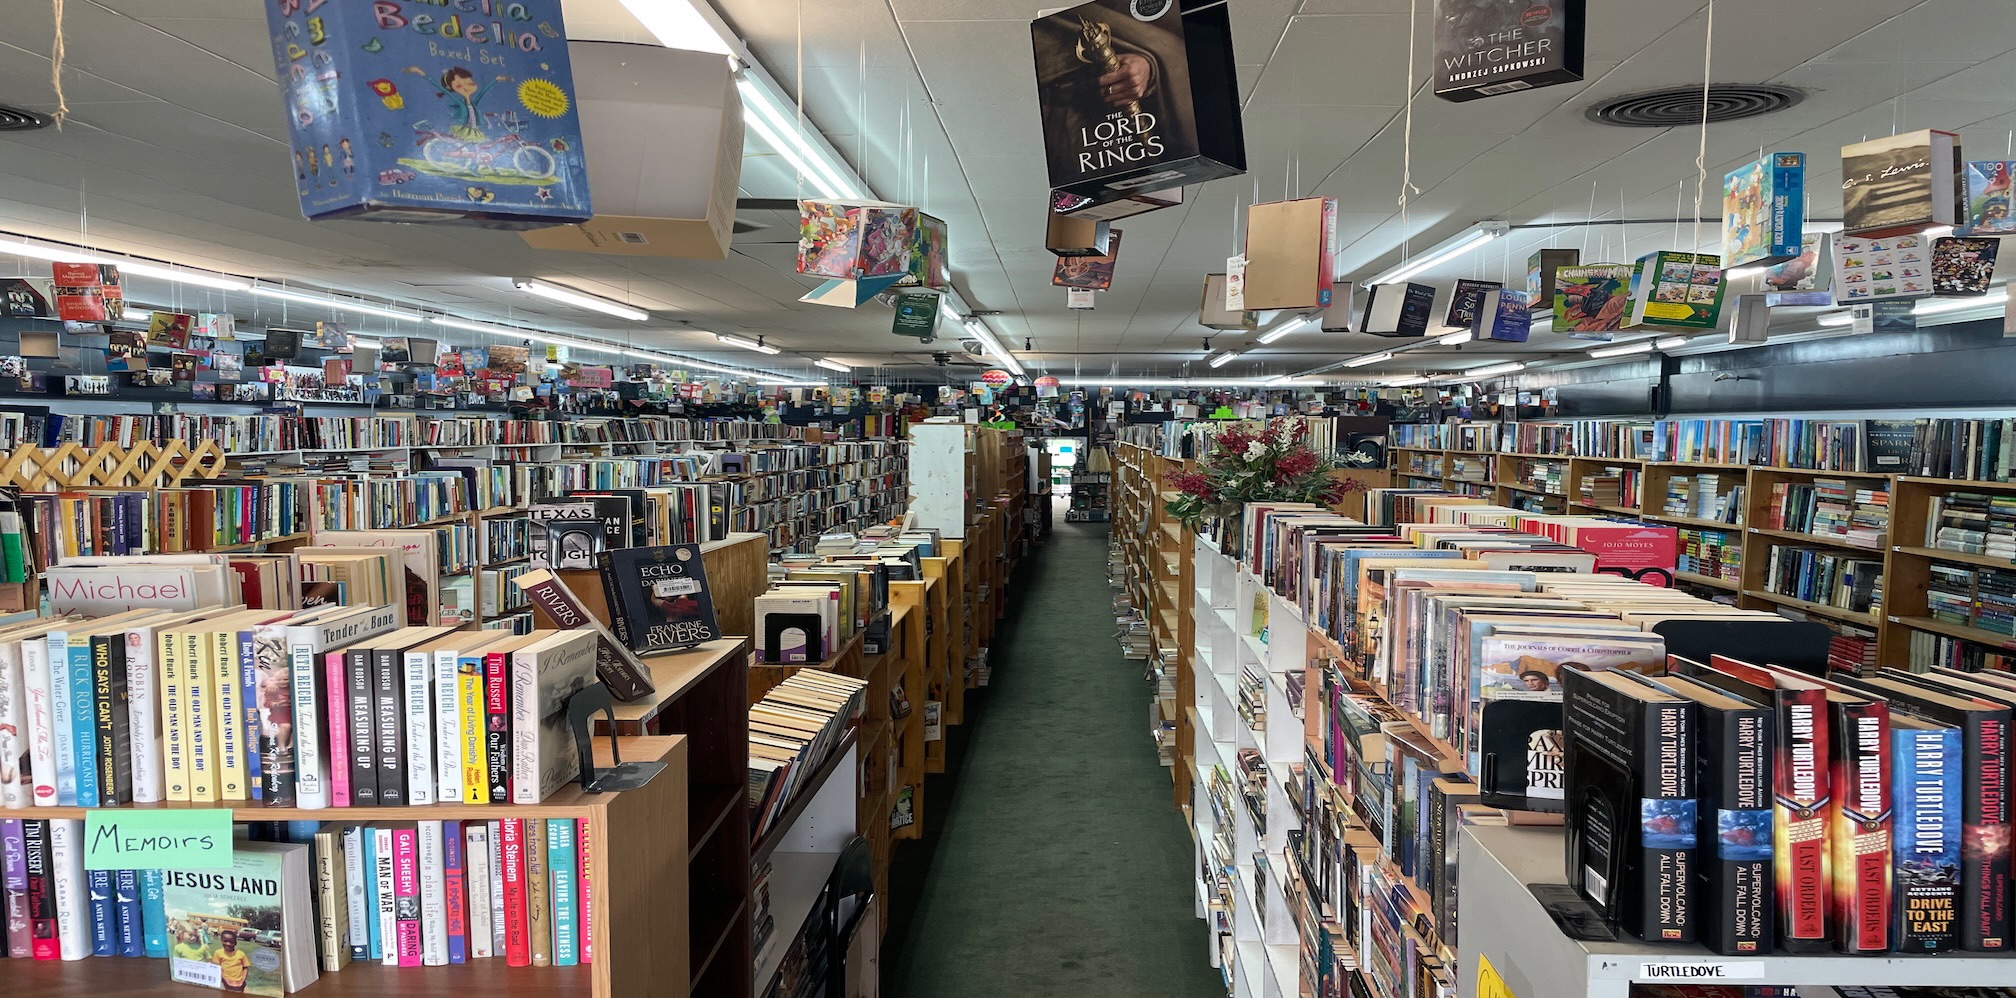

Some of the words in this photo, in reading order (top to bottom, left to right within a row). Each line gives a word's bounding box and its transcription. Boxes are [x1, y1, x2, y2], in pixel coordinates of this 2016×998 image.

[373, 1, 543, 53] Bedelia
[1488, 28, 1523, 45] THE
[428, 40, 471, 62] Boxed
[479, 49, 506, 67] Set
[1444, 39, 1552, 70] WITCHER
[1449, 70, 1489, 82] ANDRZEJ
[1492, 57, 1546, 74] SAPKOWSKI
[1105, 111, 1123, 121] THE
[1082, 112, 1156, 147] LORD
[1102, 139, 1114, 148] OF
[1116, 135, 1133, 144] THE
[1078, 136, 1165, 173] RINGS
[1983, 162, 2004, 170] 100
[1842, 179, 1857, 190] C.
[528, 508, 592, 520] TEXAS
[640, 564, 683, 577] ECHO
[54, 575, 186, 600] Michael
[536, 585, 581, 627] RIVERS
[323, 622, 359, 644] Tender
[371, 612, 394, 630] Bone
[646, 626, 712, 646] RIVERS
[650, 620, 703, 634] FRANCINE
[95, 643, 108, 667] WHO
[295, 648, 309, 671] RUTH
[354, 654, 364, 667] DAN
[380, 655, 390, 667] DAN
[1587, 648, 1632, 656] CHRISTOPHER
[53, 659, 64, 675] The
[74, 654, 88, 685] RICK
[409, 658, 423, 681] RUTH
[440, 656, 453, 679] RUTH
[489, 656, 502, 674] Tim
[54, 677, 65, 699] Water
[97, 669, 109, 694] SAYS
[126, 656, 136, 705] ROBERTS
[135, 664, 148, 700] ROBIN
[221, 683, 230, 695] THE
[355, 668, 365, 690] ROBSON
[381, 668, 391, 691] ROBSON
[466, 677, 474, 690] The
[168, 684, 176, 697] THE
[191, 686, 200, 698] THE
[297, 675, 312, 708] REICHL
[411, 684, 424, 716] REICHL
[441, 683, 454, 714] REICHL
[466, 691, 475, 706] Year
[490, 677, 502, 710] Russert
[55, 701, 67, 723] Giver
[76, 691, 91, 721] ROSS
[168, 698, 177, 712] OLD
[192, 699, 200, 713] OLD
[222, 697, 231, 710] OLD
[98, 701, 113, 730] CAN'T
[169, 713, 178, 727] MAN
[192, 714, 201, 728] MAN
[223, 712, 232, 727] MAN
[354, 696, 370, 754] MEASURING
[380, 697, 395, 754] MEASURING
[465, 713, 476, 735] Living
[1661, 708, 1677, 739] HARRY
[1791, 705, 1813, 739] HARRY
[170, 729, 179, 742] AND
[194, 730, 202, 743] AND
[224, 727, 233, 740] AND
[490, 733, 500, 749] Our
[1738, 717, 1755, 748] HARRY
[1858, 717, 1879, 751] HARRY
[1980, 719, 1998, 755] HARRY
[102, 736, 112, 756] JOTHY
[171, 743, 180, 755] THE
[195, 745, 203, 757] THE
[225, 741, 234, 754] THE
[467, 735, 477, 765] Danishly
[1915, 734, 1944, 776] HARRY
[80, 731, 94, 788] HURRICANES
[171, 756, 180, 770] BOY
[195, 758, 204, 771] BOY
[225, 755, 235, 769] BOY
[357, 756, 371, 769] UP
[383, 756, 397, 770] UP
[490, 751, 501, 784] Fathers
[1661, 740, 1677, 798] TURTLEDOVE
[104, 757, 115, 796] ROSENBERG
[1738, 749, 1755, 808] TURTLEDOVE
[1792, 742, 1815, 801] TURTLEDOVE
[1859, 754, 1881, 813] TURTLEDOVE
[1980, 755, 1999, 826] TURTLEDOVE
[1915, 780, 1944, 854] TURTLEDOVE
[25, 822, 42, 837] TIM
[548, 823, 558, 850] SCORAH
[559, 825, 570, 848] AMBER
[399, 834, 411, 856] GAIL
[27, 839, 43, 874] RUSSERT
[505, 844, 519, 882] Steinem
[1660, 854, 1671, 869] ALL
[1799, 846, 1814, 874] LAST
[378, 857, 392, 879] MAN
[400, 858, 412, 894] SHEEHY
[1736, 866, 1747, 880] ALL
[1865, 858, 1879, 885] LAST
[1980, 858, 1991, 891] THINGS
[56, 878, 67, 907] SARAH
[166, 870, 225, 890] JESUS
[230, 875, 278, 896] LAND
[380, 880, 389, 890] OF
[556, 870, 568, 903] LEAVING
[1660, 873, 1671, 894] FALL
[1675, 851, 1686, 926] SUPERVOLCANO:
[380, 891, 393, 914] WAR
[509, 898, 518, 910] Life
[1736, 884, 1747, 906] FALL
[1751, 863, 1762, 939] SUPERVOLCANO:
[1800, 876, 1816, 921] ORDERS
[1910, 898, 1953, 910] DRIVE
[1980, 893, 1991, 913] FALL
[95, 903, 104, 923] ANITA
[121, 905, 130, 926] ANITA
[558, 906, 569, 921] THE
[1660, 899, 1671, 924] DOWN
[1865, 887, 1880, 932] ORDERS
[1906, 909, 1925, 921] TO
[1929, 909, 1954, 921] THE
[59, 911, 70, 936] RUHL
[97, 923, 106, 941] SETHI
[1736, 910, 1746, 936] DOWN
[1913, 921, 1950, 933] EAST
[1980, 914, 1990, 936] APART
[123, 926, 132, 943] SETHI
[406, 923, 418, 957] DARING
[511, 930, 520, 946] Road
[558, 924, 571, 959] WITNESS
[1644, 963, 1726, 978] TURTLEDOVE
